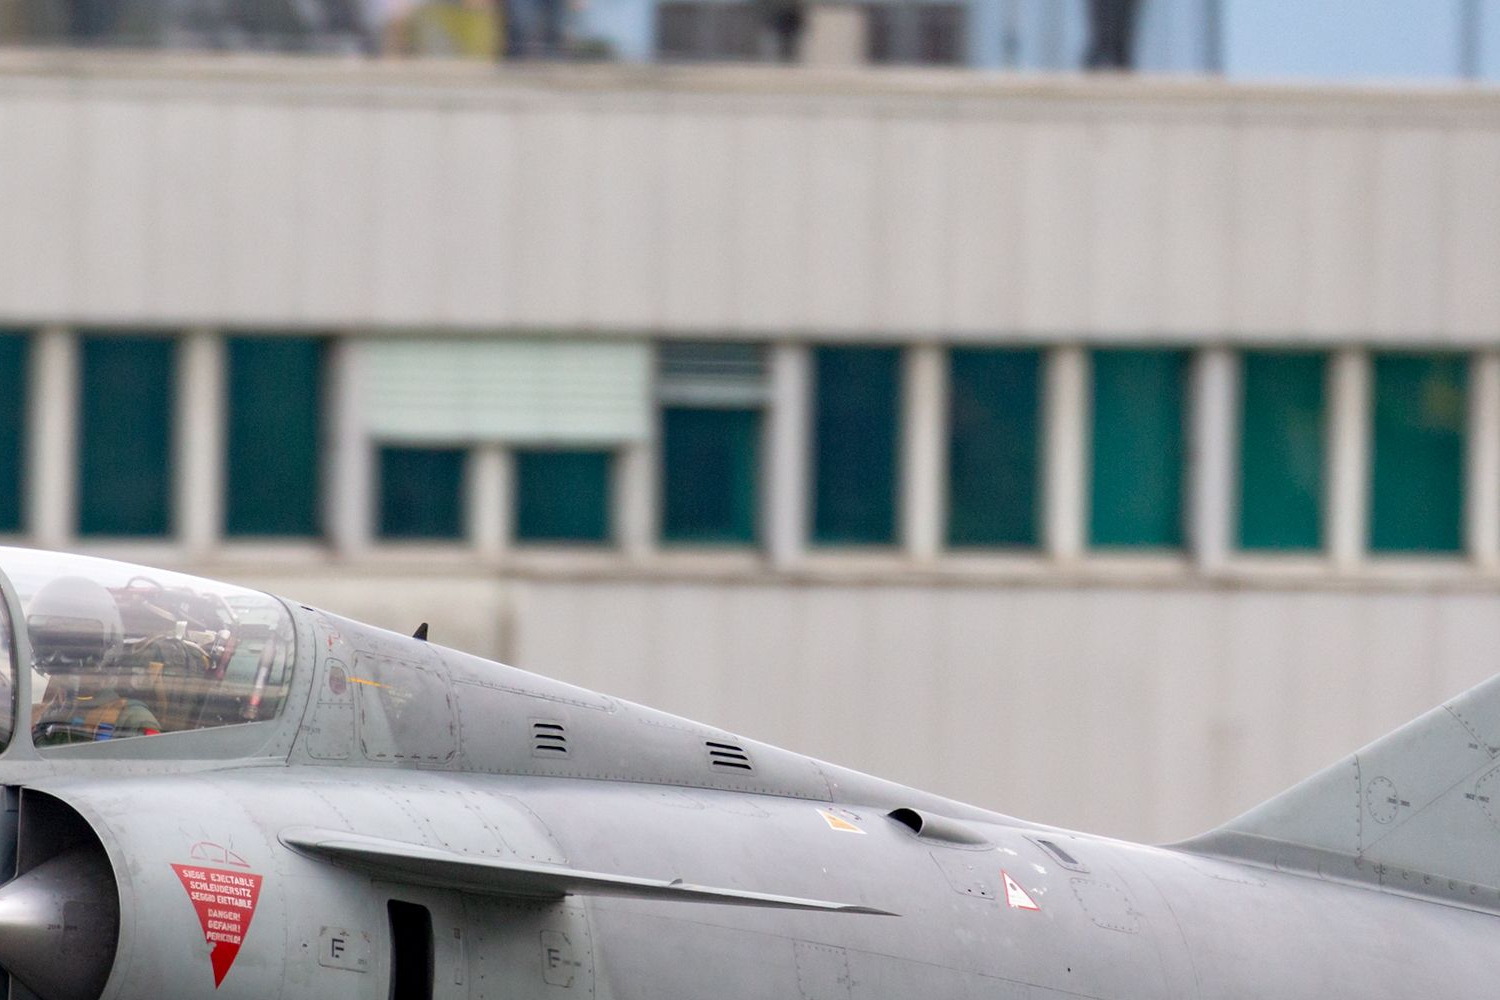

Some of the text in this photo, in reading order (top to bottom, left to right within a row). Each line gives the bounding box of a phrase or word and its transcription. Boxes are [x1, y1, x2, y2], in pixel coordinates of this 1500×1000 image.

[182, 869, 255, 888] SIEGE EJECTABLE
[189, 881, 252, 898] SCHLEUDERSITZ
[207, 908, 241, 921] DANGER!
[207, 919, 241, 933] GEFAHR!
